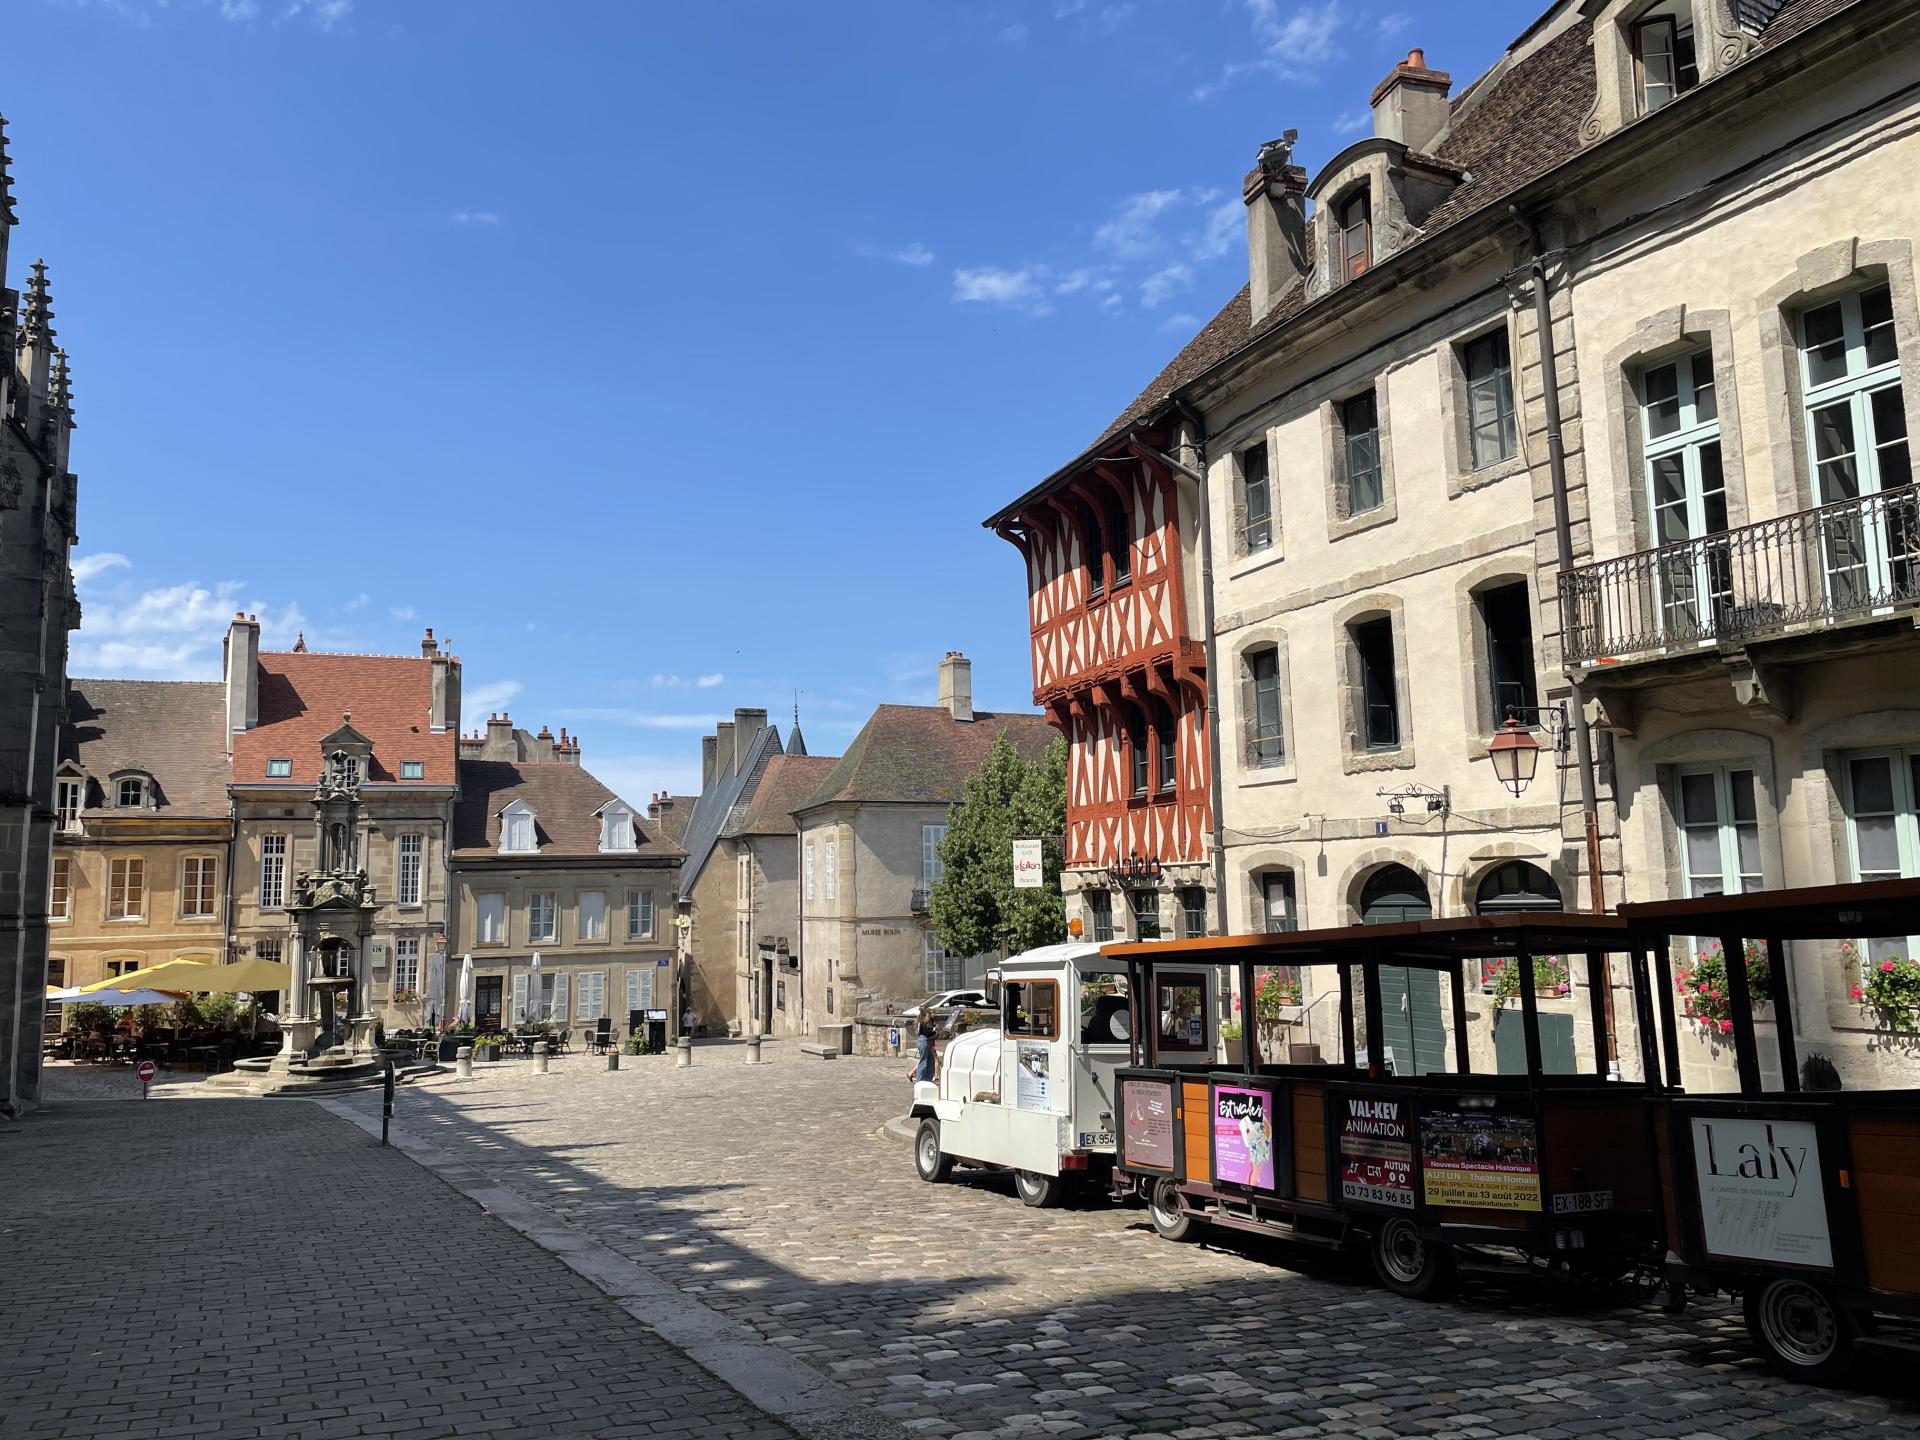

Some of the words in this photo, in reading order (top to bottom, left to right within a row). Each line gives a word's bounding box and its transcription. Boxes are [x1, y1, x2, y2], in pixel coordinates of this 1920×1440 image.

[883, 928, 901, 936] ROLIN
[1219, 1096, 1263, 1118] Estivales
[1348, 1099, 1398, 1120] VAL-KEV
[1345, 1119, 1405, 1137] ANIMATION
[1384, 1160, 1410, 1173] AUTUN
[1430, 1160, 1460, 1168] Nouveau
[1460, 1162, 1494, 1171] Spectacle
[1495, 1163, 1531, 1173] Historique
[1701, 1124, 1807, 1198] Laly
[1426, 1170, 1461, 1180] AUTUN
[1504, 1175, 1537, 1184] Romain
[1449, 1181, 1484, 1189] SPECTACLE
[1345, 1184, 1356, 1196] 03
[1358, 1186, 1369, 1198] 73
[1371, 1188, 1383, 1201] 83
[1385, 1190, 1397, 1203] 96
[1400, 1192, 1412, 1205] 85
[1427, 1187, 1439, 1196] 29
[1441, 1189, 1465, 1198] juillet
[1480, 1191, 1490, 1199] 13
[1492, 1192, 1512, 1201] août
[1514, 1193, 1538, 1202] 2022
[1446, 1198, 1519, 1209] www.augustodunum.fr
